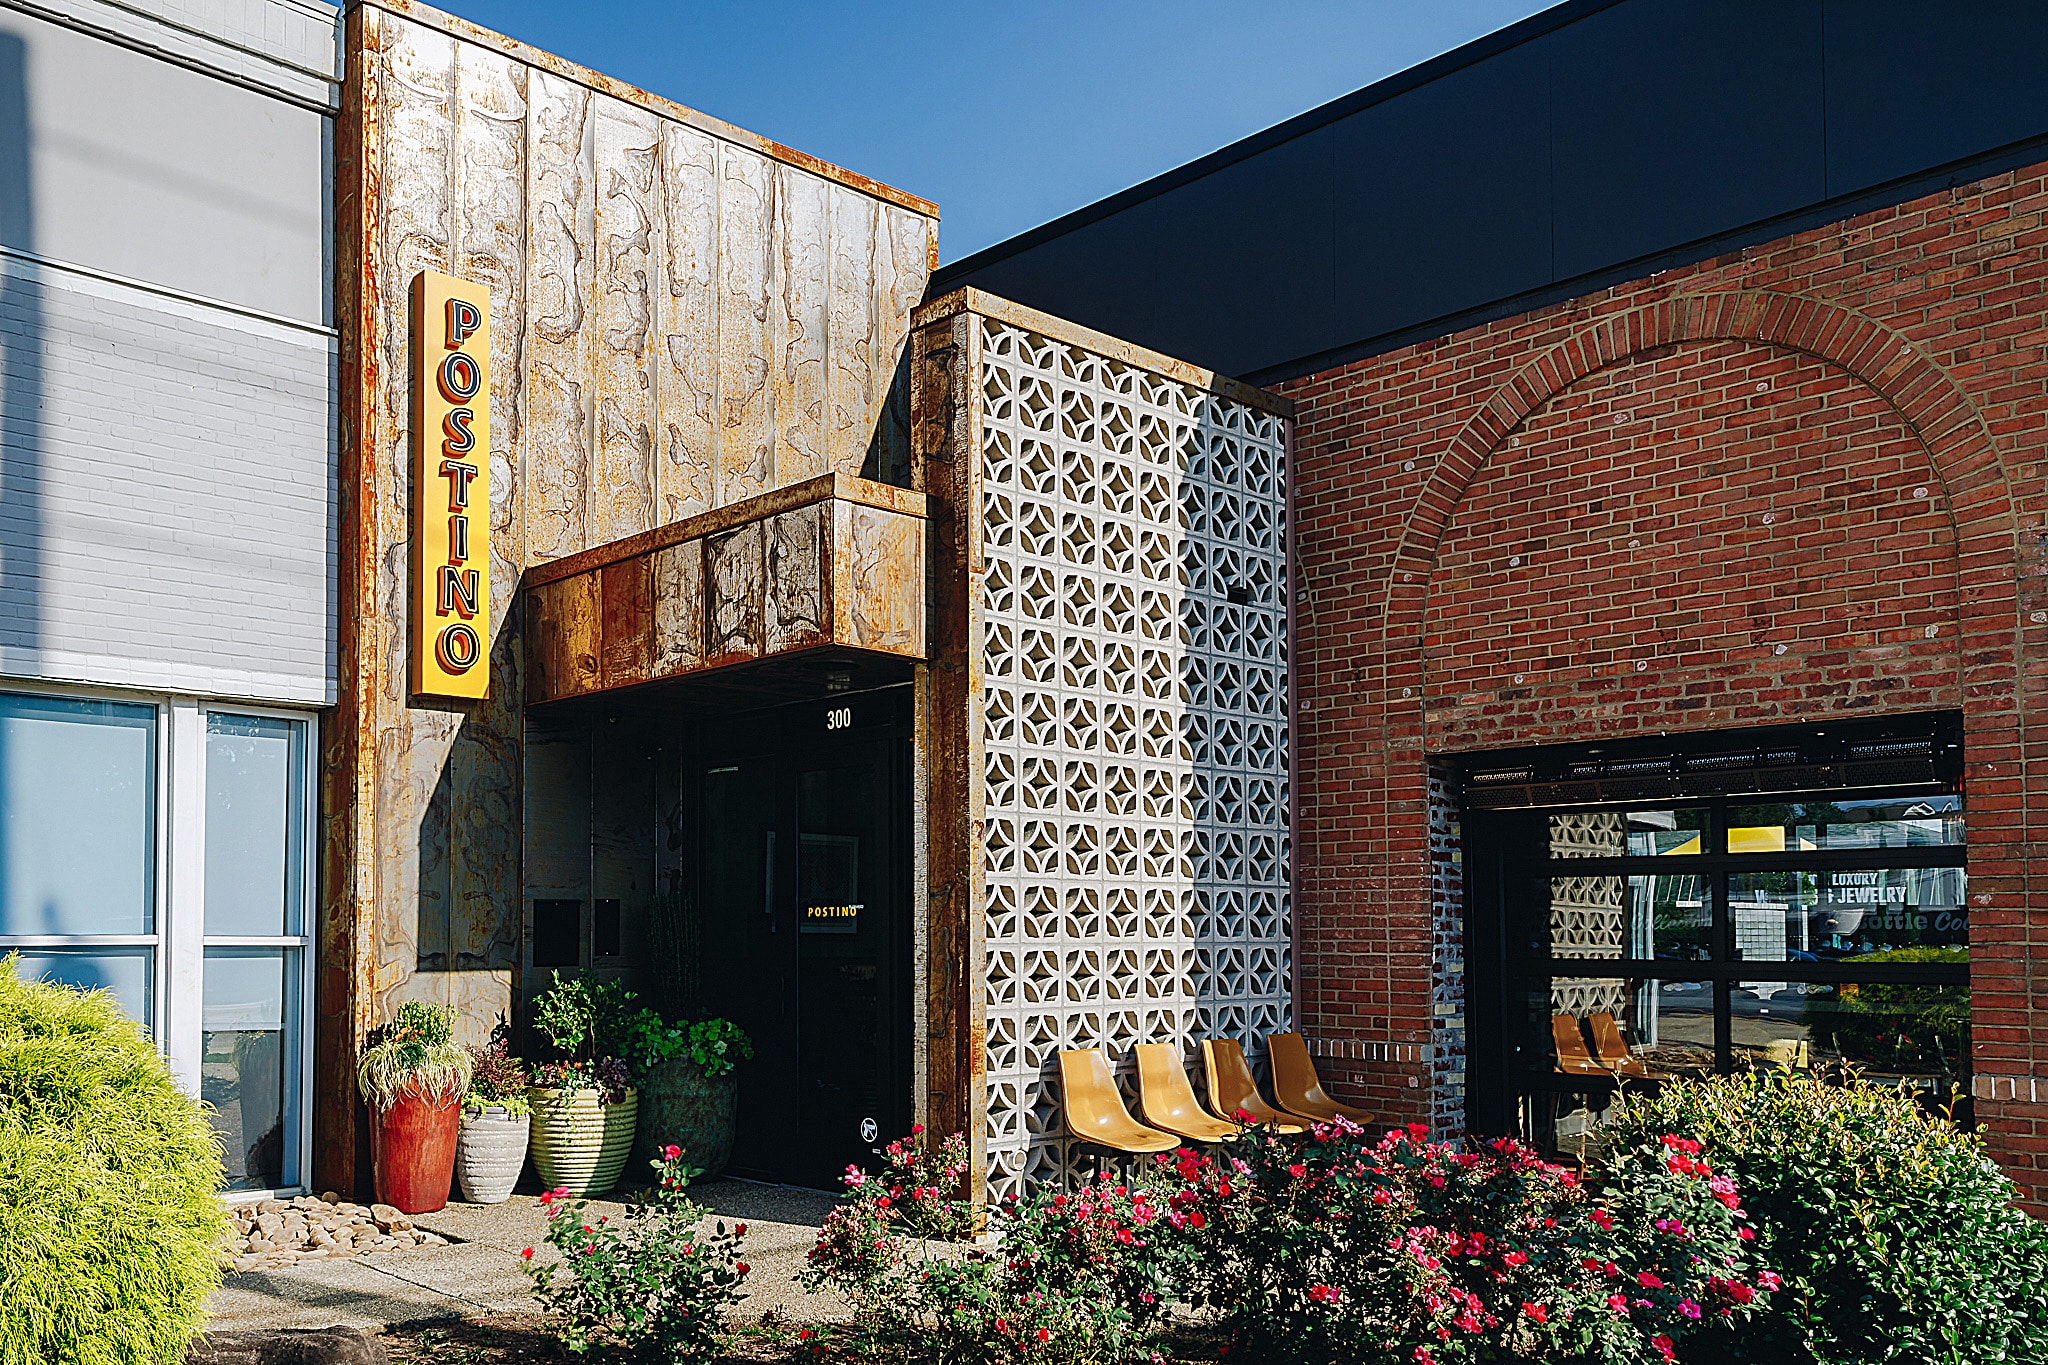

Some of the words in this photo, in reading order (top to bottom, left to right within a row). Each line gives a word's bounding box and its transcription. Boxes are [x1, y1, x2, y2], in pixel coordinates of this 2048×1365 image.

[436, 297, 482, 677] POSTINO
[826, 707, 851, 730] 300
[1831, 872, 1878, 886] LUXURY
[1837, 886, 1907, 904] JEWELRY
[807, 906, 857, 918] POSTINO
